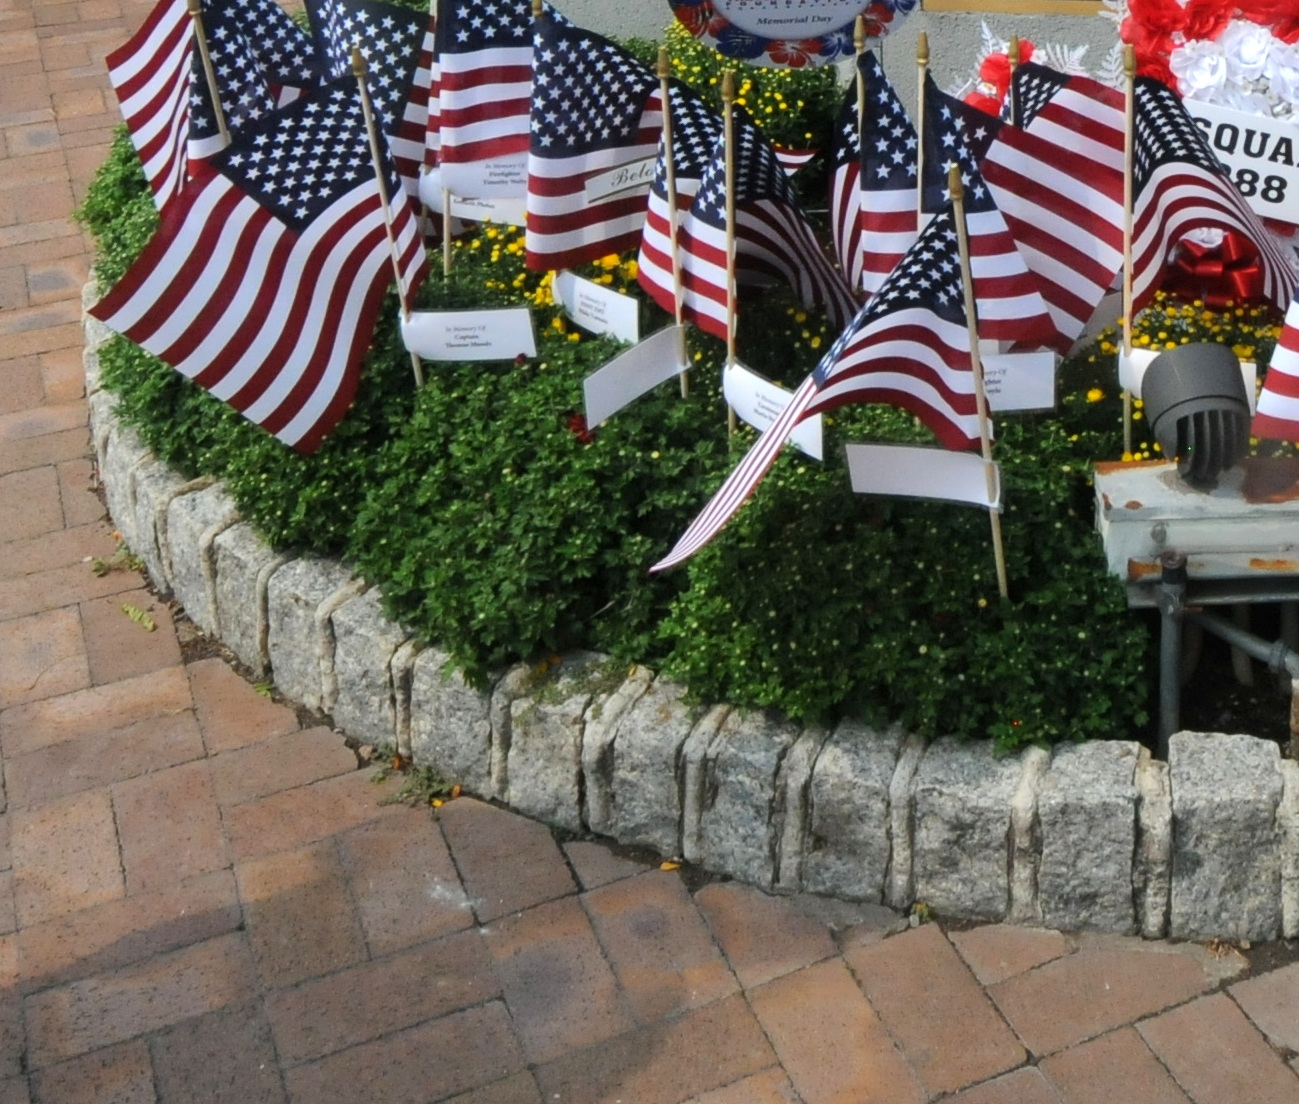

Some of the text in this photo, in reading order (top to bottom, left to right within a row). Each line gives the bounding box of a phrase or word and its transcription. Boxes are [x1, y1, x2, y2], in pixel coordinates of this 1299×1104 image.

[756, 15, 833, 25] Memorial Day
[1221, 163, 1288, 204] 88
